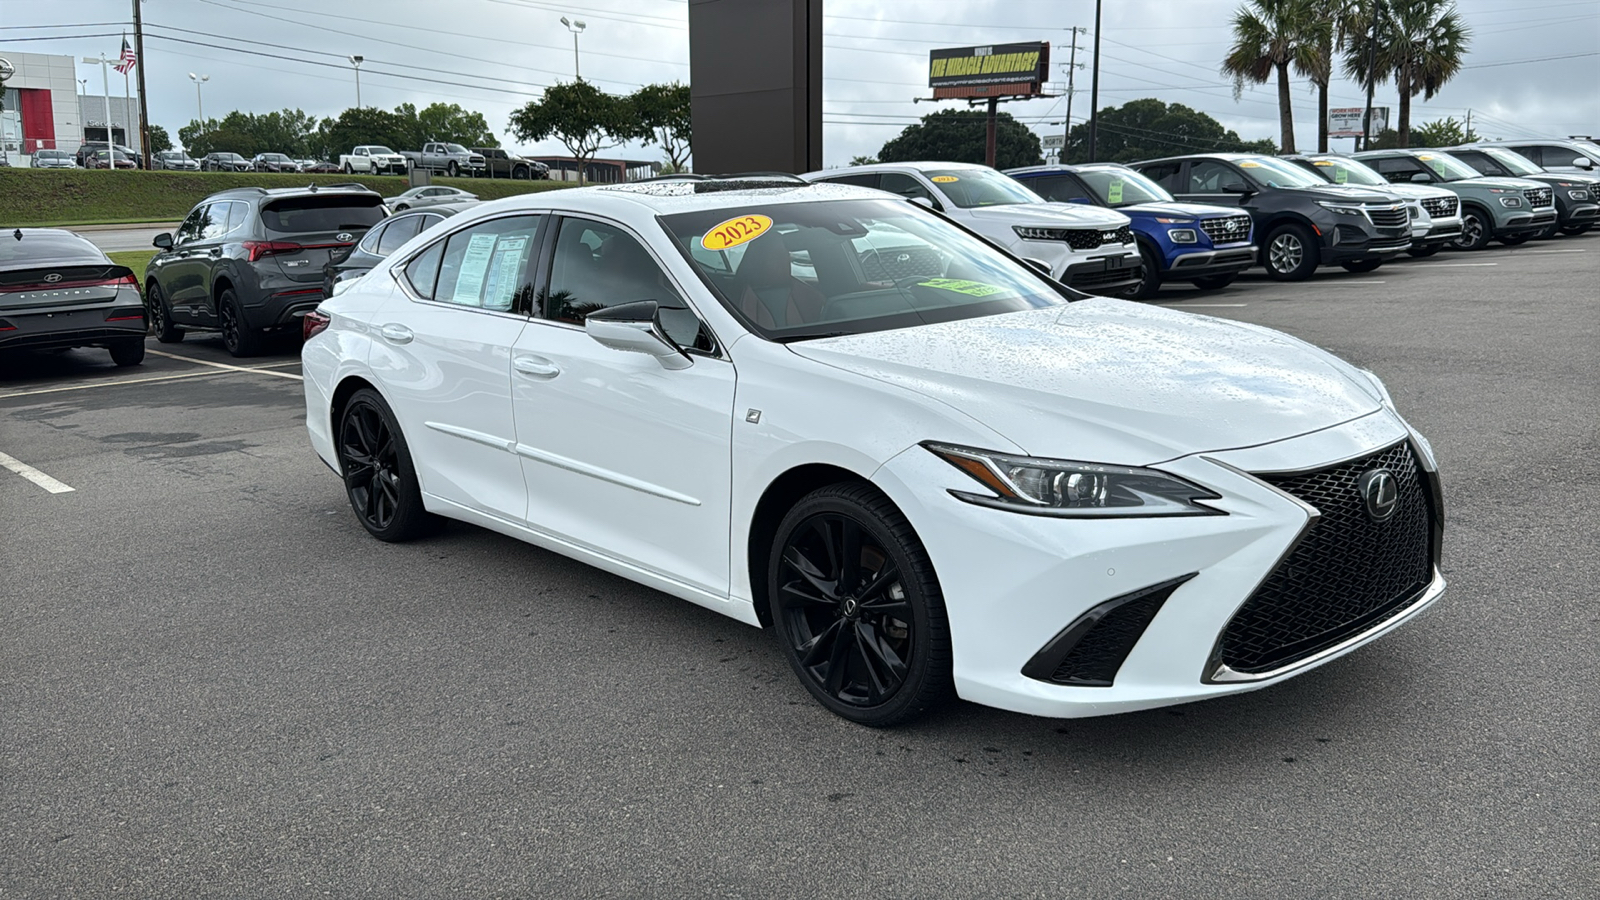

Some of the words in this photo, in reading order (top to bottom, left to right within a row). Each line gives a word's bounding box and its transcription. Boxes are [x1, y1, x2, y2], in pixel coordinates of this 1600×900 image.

[975, 47, 987, 56] WHAT
[931, 59, 946, 77] THE
[946, 56, 982, 76] MIRACLE
[982, 52, 1039, 74] ADVANTAGE?
[87, 119, 120, 127] Servce
[1044, 138, 1063, 146] NORTH
[714, 217, 762, 246] 2023
[20, 289, 91, 299] ELANTRA
